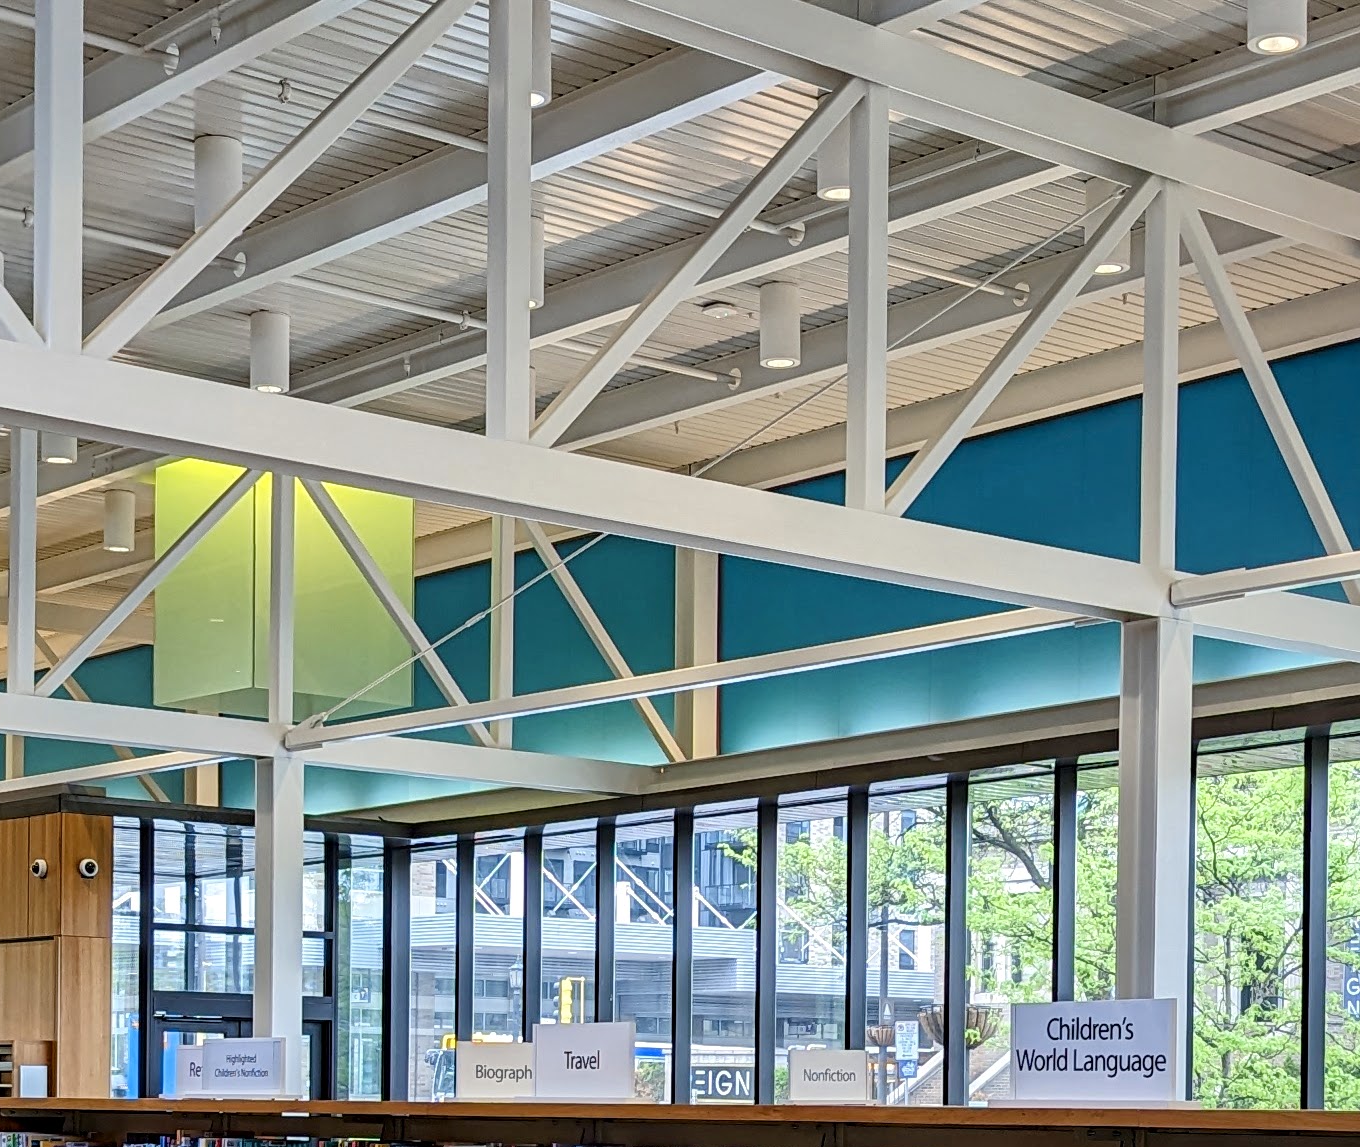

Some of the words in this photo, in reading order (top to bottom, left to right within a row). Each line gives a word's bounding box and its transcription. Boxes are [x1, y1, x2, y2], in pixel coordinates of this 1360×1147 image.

[1046, 1016, 1134, 1041] Children's
[225, 1054, 257, 1066] Highlighted
[564, 1049, 600, 1070] Travel
[1016, 1048, 1068, 1072] World
[1072, 1049, 1167, 1079] Language
[189, 1061, 203, 1078] Re
[214, 1067, 240, 1079] Children's
[241, 1067, 269, 1079] Nonfiction
[475, 1063, 533, 1083] Biograph
[803, 1068, 857, 1083] Nonfiction
